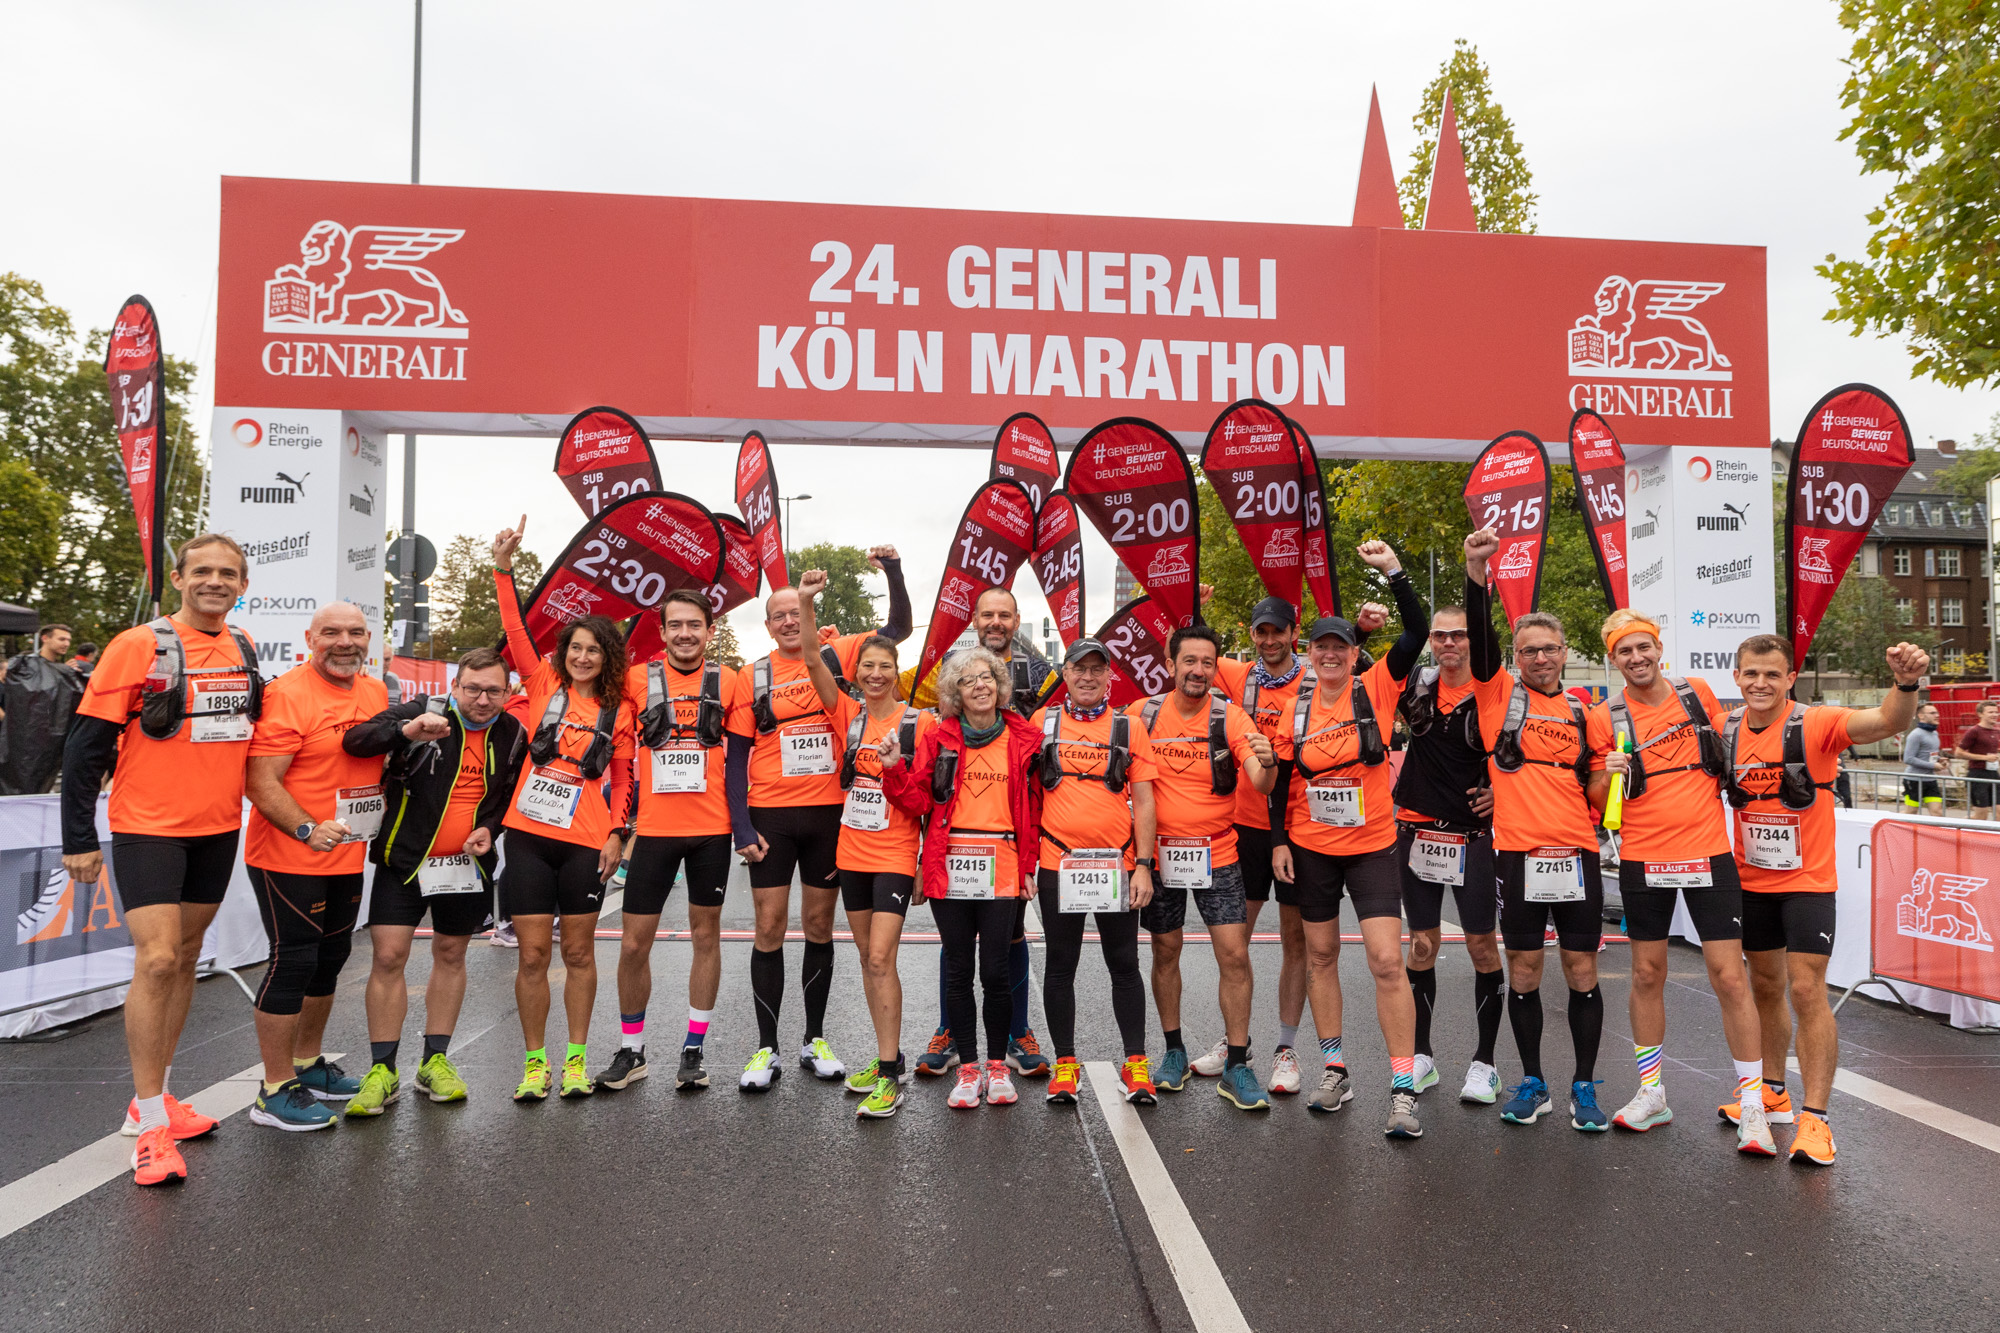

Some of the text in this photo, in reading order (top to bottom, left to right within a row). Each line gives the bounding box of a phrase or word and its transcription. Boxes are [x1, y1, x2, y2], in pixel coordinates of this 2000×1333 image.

[809, 240, 1277, 320] 24. GENERALI
[262, 341, 468, 381] GENERALI
[757, 311, 1346, 406] KÖLN MARATHON
[1569, 383, 1733, 418] GENERALI
[269, 422, 309, 435] Rhein
[1821, 409, 1879, 432] #GENERALI
[574, 428, 620, 449] #GENERALI
[1011, 426, 1044, 447] #GENERALI
[1224, 420, 1272, 441] #GENERALI
[1250, 433, 1283, 444] BEWEGT
[1851, 428, 1893, 441] BEWEGT
[268, 435, 323, 449] Energie
[361, 435, 377, 453] Rhein
[598, 435, 632, 448] BEWEGT
[1225, 443, 1280, 456] DEUTSCHLAND
[1822, 438, 1888, 453] DEUTSCHLAND
[576, 445, 629, 462] DEUTSCHLAND
[1012, 447, 1049, 465] DEUTSCHLAND
[1028, 444, 1051, 457] BEWEGT
[1093, 442, 1152, 465] #GENERALI
[1125, 451, 1167, 465] BEWEGT
[1484, 449, 1526, 471] #GENERALI
[1504, 456, 1535, 470] BEWEGT
[1716, 460, 1747, 471] Rhein
[999, 464, 1014, 476] SUB
[1095, 462, 1163, 480] DEUTSCHLAND
[1232, 470, 1254, 483] SUB
[1481, 466, 1530, 483] DEUTSCHLAND
[1641, 464, 1660, 478] Rhein
[1716, 471, 1759, 484] Energie
[1801, 465, 1824, 478] SUB
[582, 472, 604, 485] SUB
[1581, 474, 1594, 486] SUB
[1641, 473, 1666, 490] Energie
[240, 487, 295, 504] PUMA
[990, 488, 1025, 517] #GENERALI
[1104, 493, 1132, 506] SUB
[1234, 480, 1300, 519] 2:00
[1482, 492, 1502, 505] SUB
[1588, 483, 1625, 522] 1:45
[1801, 480, 1870, 527] 1:30
[350, 493, 371, 516] PUMA
[747, 484, 771, 535] 1:45
[987, 508, 1025, 538] DEUTSCHLAND
[1006, 511, 1030, 530] BEWEGT
[1111, 498, 1189, 543] 2:00
[1481, 496, 1543, 534] 2:15
[645, 502, 704, 545] #GENERALI
[965, 521, 983, 538] SUB
[1631, 521, 1655, 541] PUMA
[1697, 516, 1739, 531] PUMA
[598, 527, 628, 550] SUB
[636, 521, 702, 567] DEUTSCHLAND
[670, 532, 712, 560] BEWEGT
[256, 548, 308, 565] ALKOHOLFREI
[730, 548, 755, 573] BEWEGT
[960, 535, 1008, 585] 1:45
[1041, 549, 1054, 565] SUB
[1262, 556, 1299, 568] GENERALI
[573, 539, 666, 607] 2:30
[1043, 542, 1081, 595] 2:45
[1497, 568, 1531, 579] GENERALI
[1696, 555, 1753, 580] Reissdorf
[1147, 572, 1190, 588] GENERALI
[1712, 569, 1752, 585] ALKOHOLFREI
[249, 596, 317, 615] pixum
[938, 602, 968, 622] GENERALI
[1126, 617, 1147, 639] SUB
[1708, 612, 1760, 629] pixum
[1105, 625, 1170, 695] 2:45
[1690, 652, 1737, 670] REW
[206, 695, 247, 709] 18982
[214, 715, 240, 723] Martin
[791, 736, 828, 750] 12414
[661, 753, 700, 765] 12809
[1058, 750, 1109, 761] ACEMAKE
[546, 770, 577, 784] GENERALI
[963, 771, 1009, 784] CEMAKER
[532, 779, 572, 799] 27485
[851, 790, 882, 804] 19923
[1315, 790, 1352, 802] 12411
[348, 799, 382, 814] 10056
[851, 806, 877, 815] Cornelia
[1325, 806, 1345, 814] Gaby
[1429, 834, 1458, 842] GENERALI
[1748, 826, 1790, 841] 17344
[1166, 850, 1203, 862] 12417
[1420, 843, 1457, 858] 12410
[1756, 844, 1782, 853] Henrik
[428, 854, 471, 867] 27396
[949, 859, 986, 871] 12415
[1425, 859, 1448, 868] Daniel
[1535, 860, 1573, 874] 27415
[1661, 863, 1691, 872] LÄUFT.
[954, 876, 979, 884] Sibylle
[1070, 872, 1108, 884] 12413
